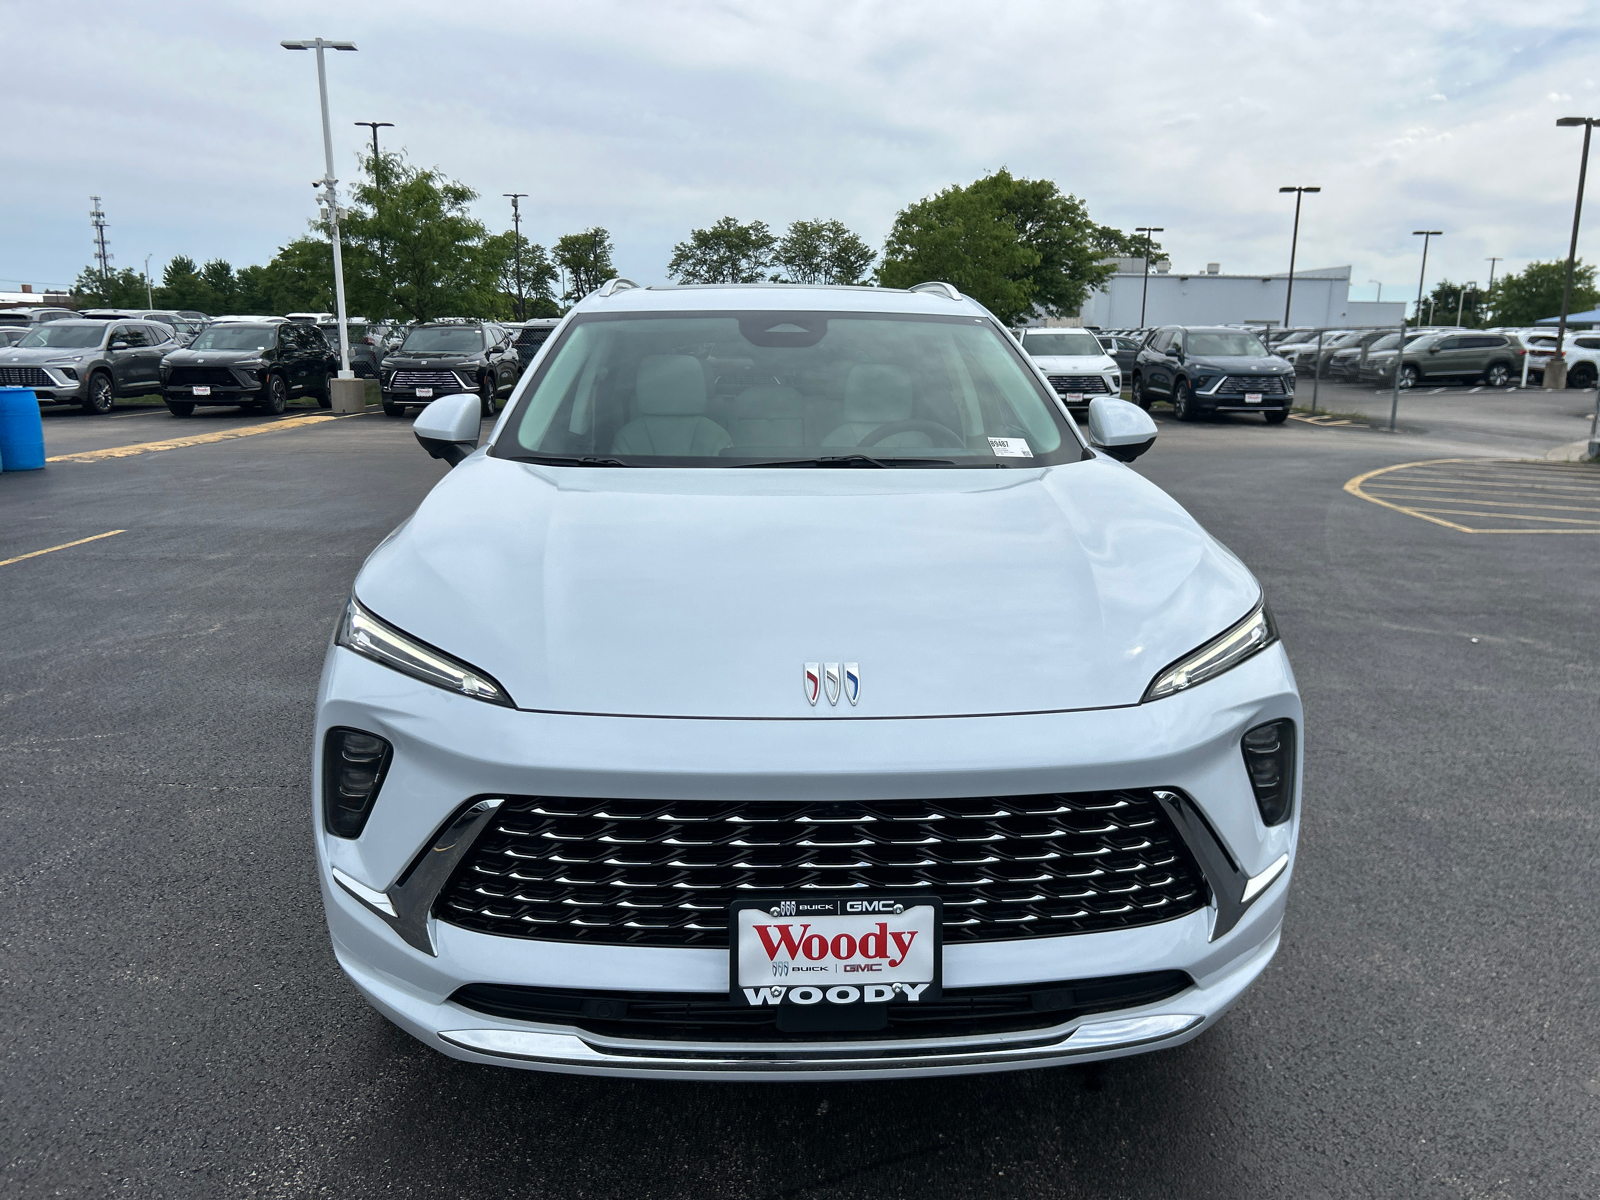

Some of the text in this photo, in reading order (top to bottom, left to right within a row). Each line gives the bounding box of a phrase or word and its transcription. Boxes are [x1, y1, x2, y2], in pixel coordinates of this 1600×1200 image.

[846, 901, 895, 912] GMC
[752, 922, 919, 967] Woody
[843, 963, 883, 972] GMC
[743, 983, 931, 1006] WOODY
